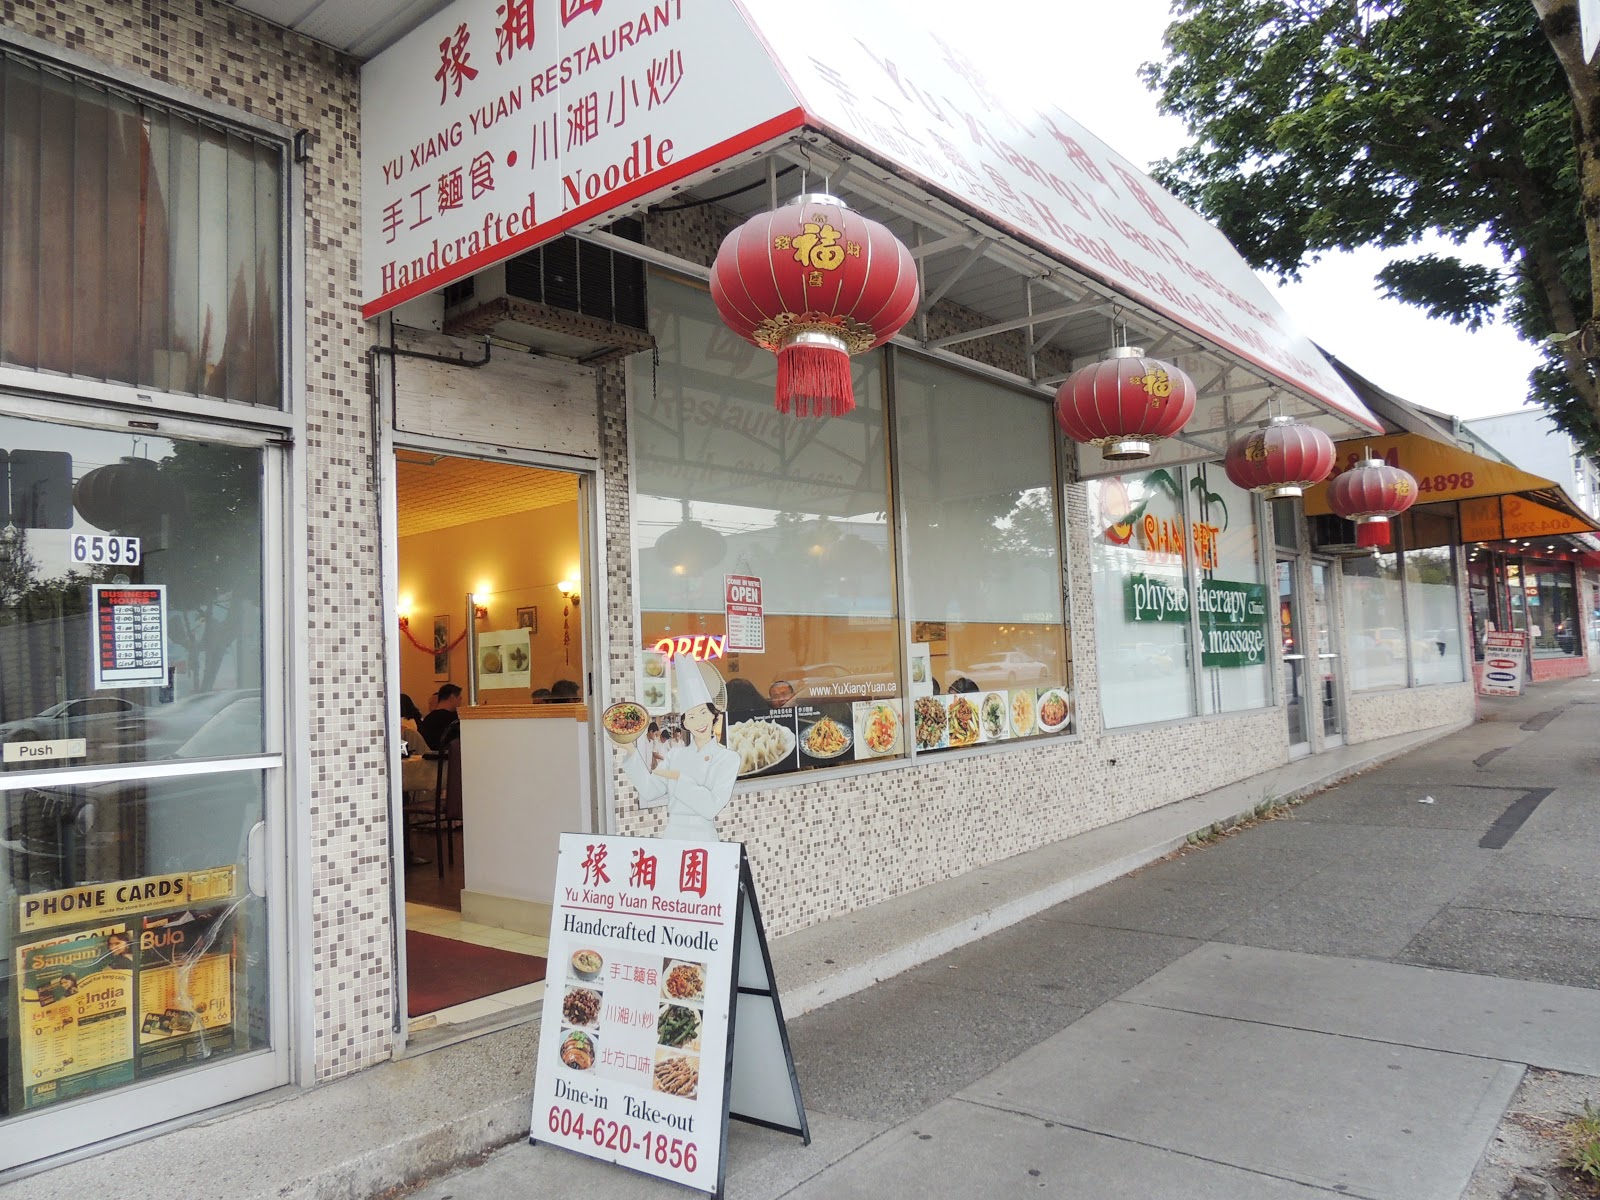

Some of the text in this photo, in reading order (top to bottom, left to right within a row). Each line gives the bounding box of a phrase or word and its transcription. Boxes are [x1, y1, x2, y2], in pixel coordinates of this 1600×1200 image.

[382, 0, 683, 187] YU XIANG YUAN RESTAURANT
[530, 49, 684, 170] 川湘小炒
[380, 134, 674, 295] Handcrafted Noodle
[940, 94, 1094, 222] Xiang
[1069, 180, 1172, 266] Yuan
[1155, 237, 1288, 338] Restauran
[1019, 189, 1226, 333] Handcrafted
[74, 535, 138, 563] 6595
[1145, 513, 1219, 570] SUNSET
[731, 585, 759, 603] OPEN
[655, 635, 727, 662] OPEN
[1209, 629, 1263, 661] massage
[809, 681, 897, 697] www.YuXiangYuan.ca
[20, 745, 53, 757] Push
[26, 878, 184, 918] PHONE CARDS
[565, 887, 722, 917] Yu Xiang Yuan Restaurant
[141, 928, 184, 950] Bula
[563, 913, 719, 951] Handcrafted Noodle
[86, 987, 124, 1004] India
[98, 1000, 117, 1010] 312
[209, 997, 226, 1011] Fiji
[605, 1005, 654, 1029] 川湘小炒
[601, 1048, 651, 1074] 北方口味
[554, 1078, 695, 1133] Dine-in Take-out
[549, 1105, 698, 1173] 604-620-1856
